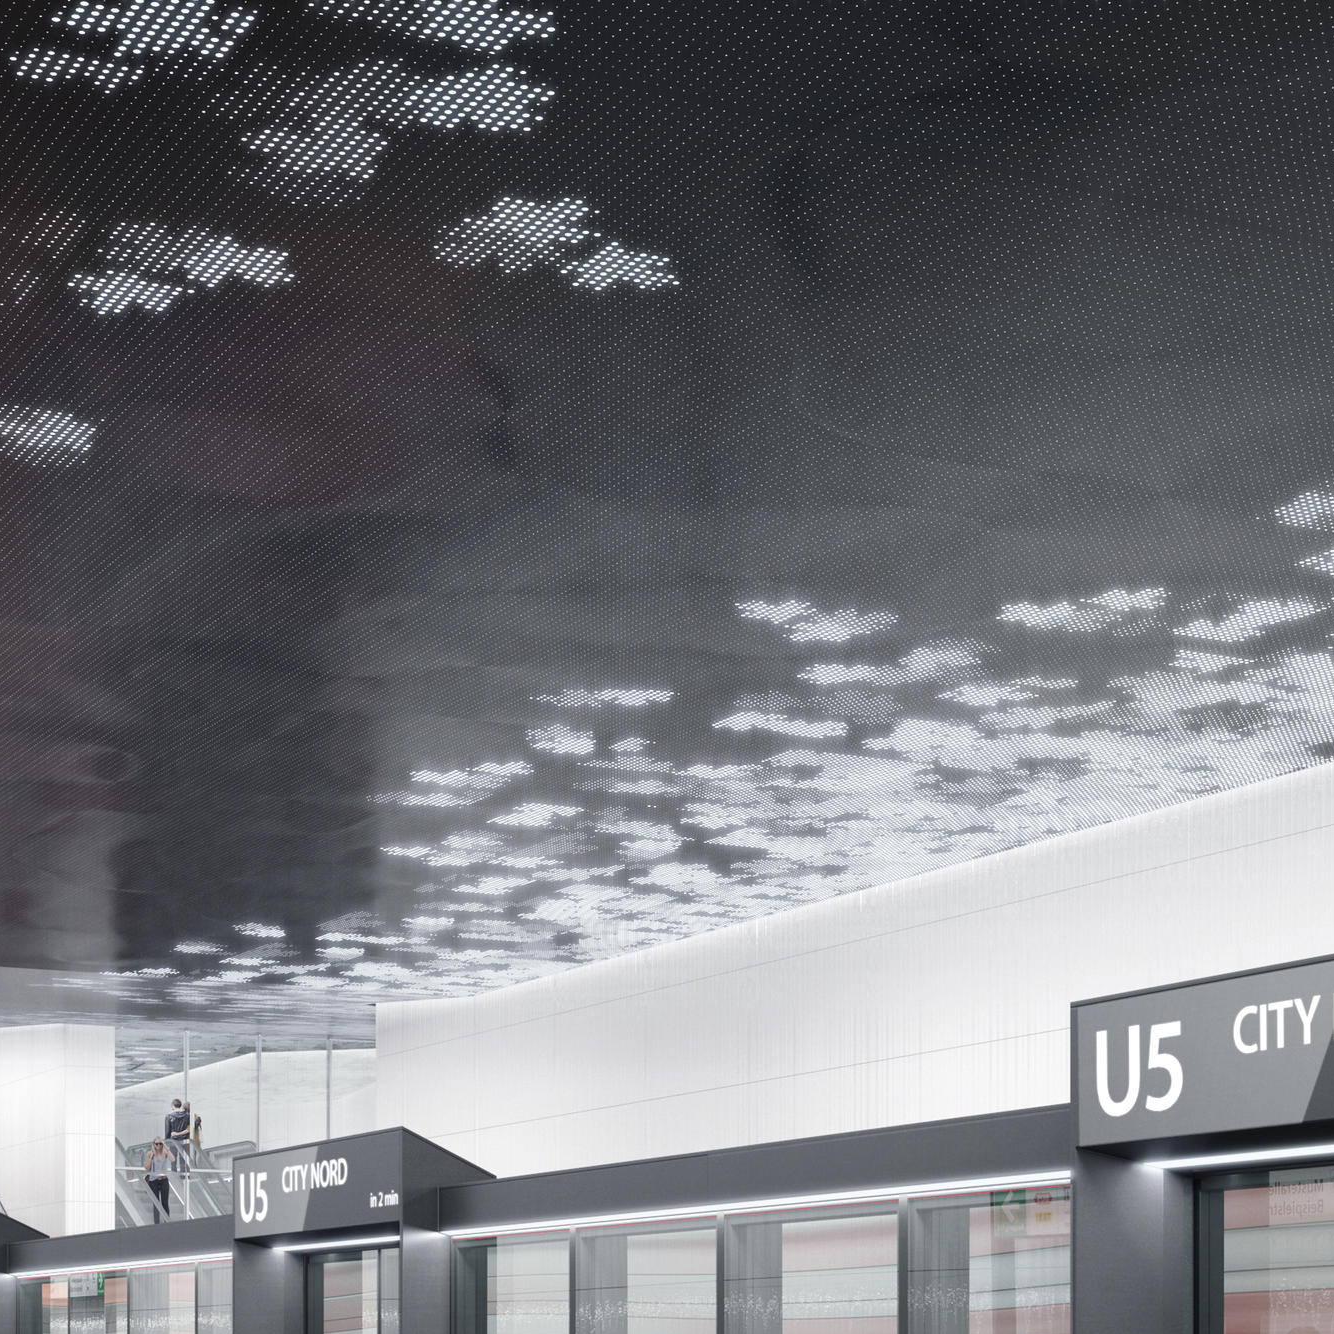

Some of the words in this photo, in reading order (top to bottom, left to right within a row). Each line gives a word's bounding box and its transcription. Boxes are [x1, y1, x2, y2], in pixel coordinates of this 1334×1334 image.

[1232, 993, 1321, 1054] CITY
[1096, 1020, 1184, 1117] U5
[239, 1171, 269, 1224] U5
[281, 1164, 309, 1193] CITY
[310, 1157, 348, 1189] NORD
[369, 1192, 378, 1208] in
[378, 1191, 384, 1207] 2
[384, 1189, 399, 1207] min
